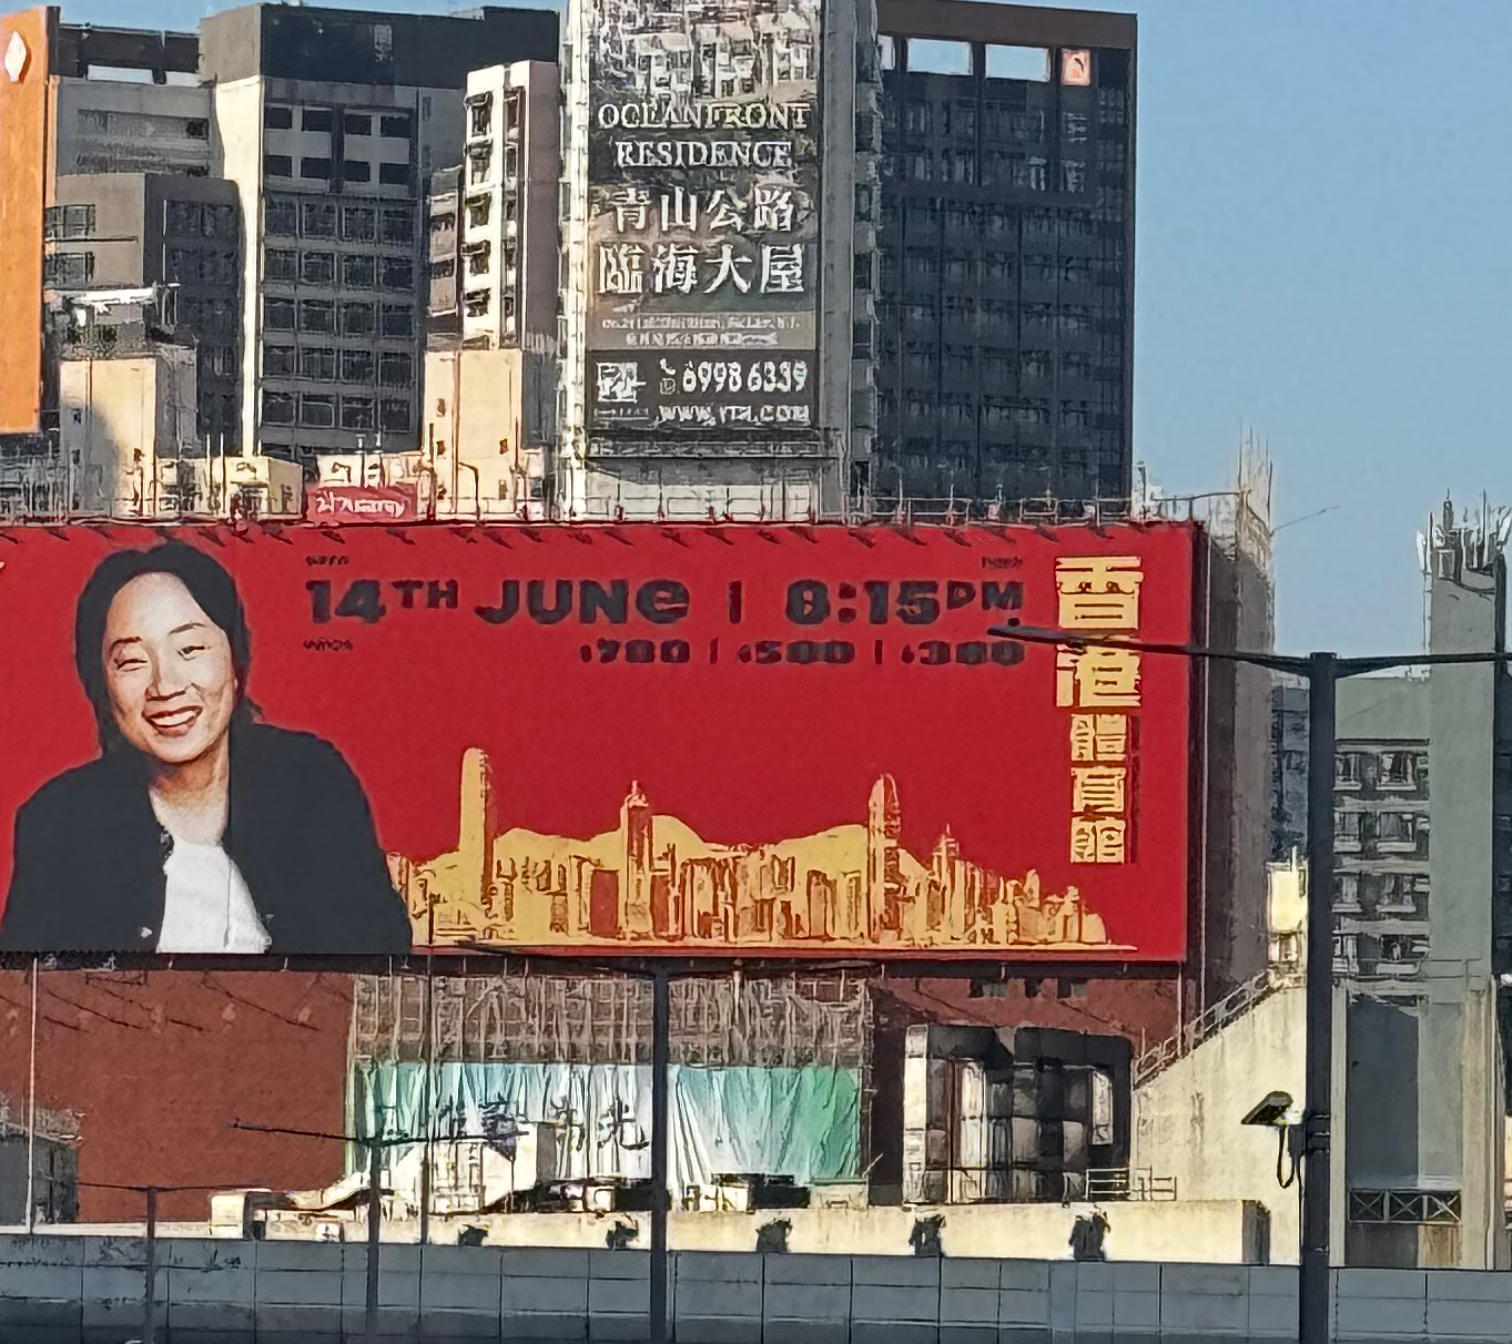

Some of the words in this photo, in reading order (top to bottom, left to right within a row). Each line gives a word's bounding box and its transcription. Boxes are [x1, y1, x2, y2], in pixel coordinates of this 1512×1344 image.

[597, 103, 813, 131] OCEANFRONT
[616, 141, 794, 169] RESIDENCE
[613, 186, 794, 232] 青山公路
[598, 242, 806, 295] 臨海大屋
